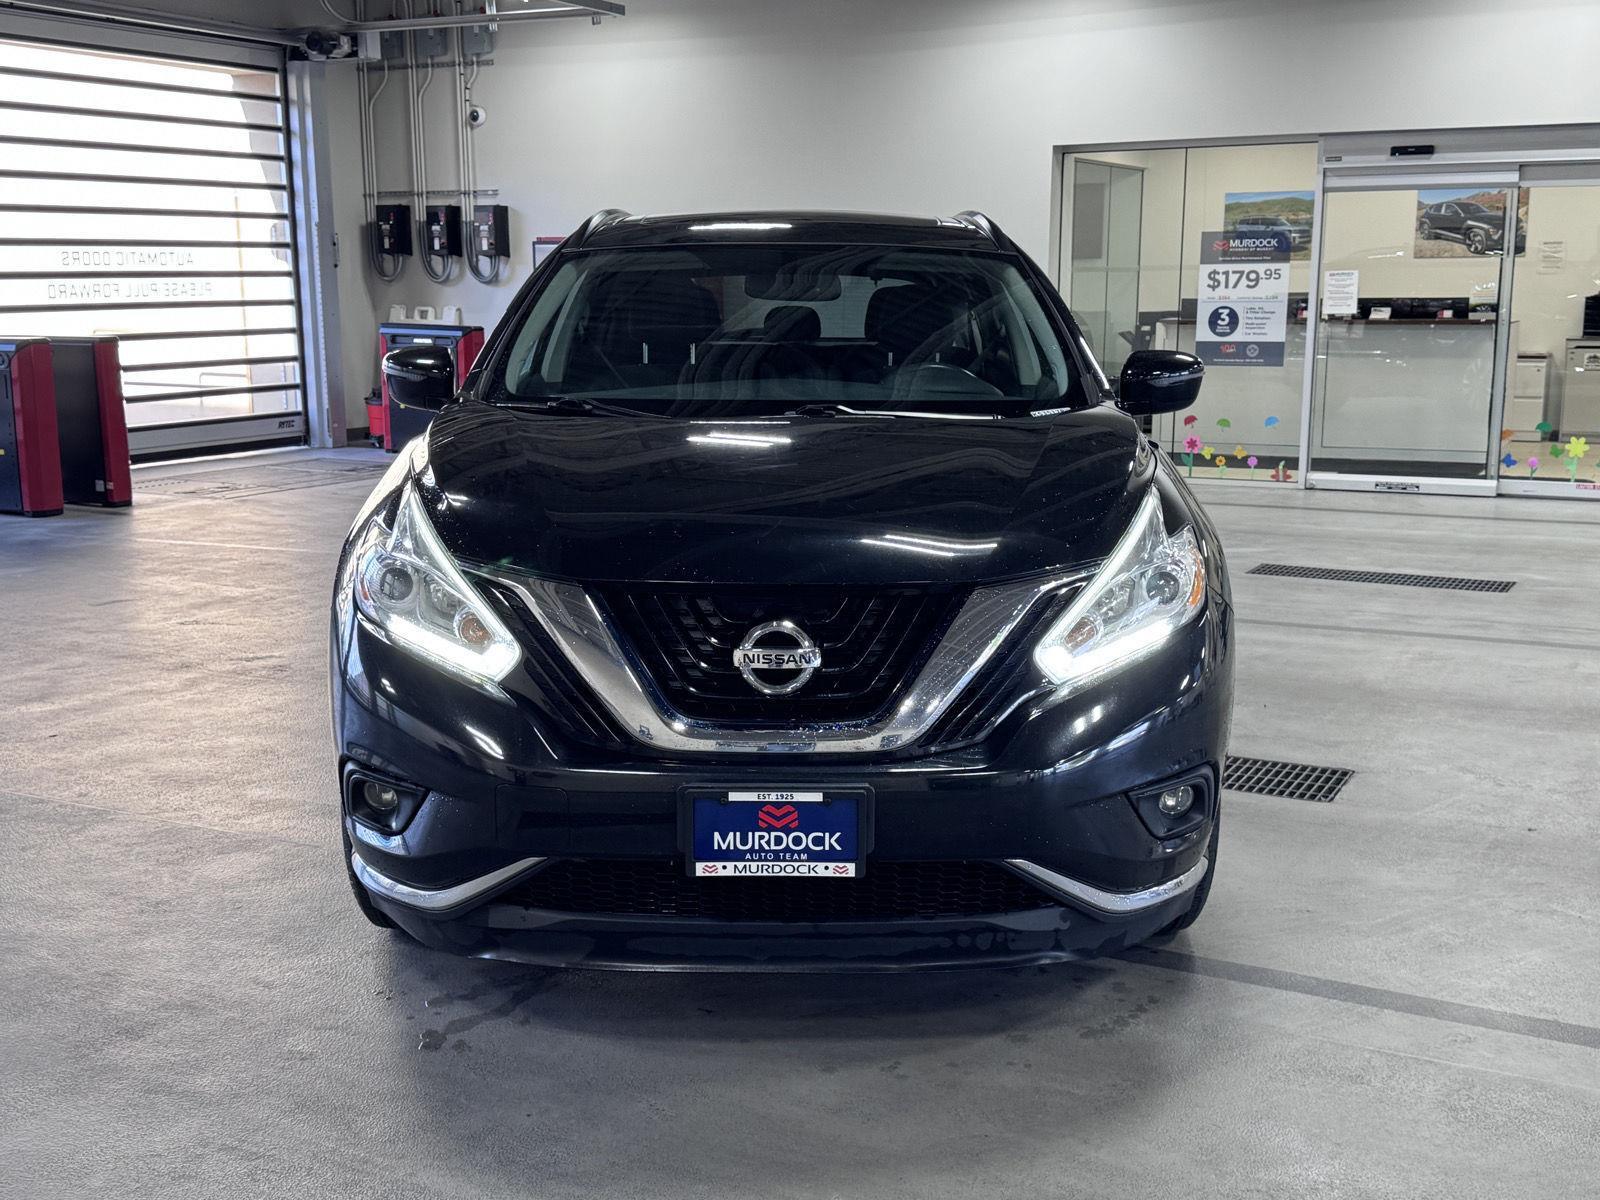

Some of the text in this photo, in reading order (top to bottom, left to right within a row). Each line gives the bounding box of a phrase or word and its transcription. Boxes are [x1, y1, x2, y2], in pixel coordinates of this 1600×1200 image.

[1229, 238, 1278, 247] MURDOCK
[1217, 308, 1230, 326] 3
[743, 653, 811, 665] NISSAN
[713, 831, 842, 851] MURDOCK
[745, 852, 808, 860] AUTO TEAM
[733, 864, 819, 875] MURDOCK
